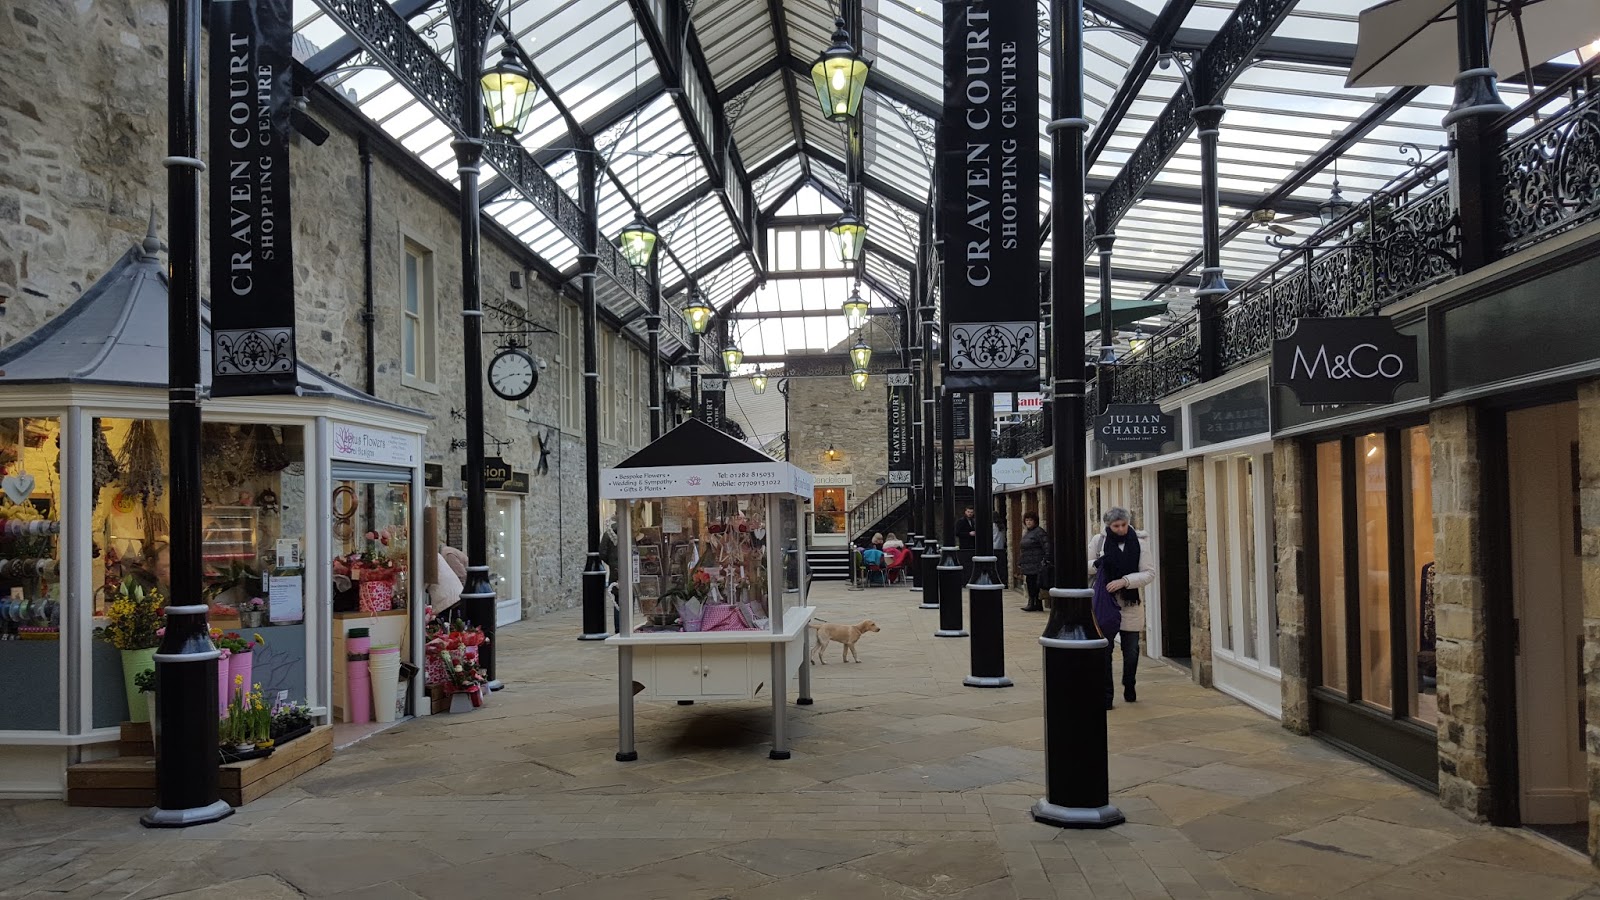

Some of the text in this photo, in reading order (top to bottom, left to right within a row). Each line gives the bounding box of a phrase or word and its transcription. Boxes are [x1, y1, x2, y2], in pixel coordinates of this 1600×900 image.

[229, 32, 252, 296] CRAVEN COURT
[258, 64, 274, 260] SHOPPING CENTRE
[966, 5, 991, 287] CRAVEN COURT
[1001, 41, 1018, 250] SHOPPING CENTRE
[892, 395, 900, 425] COURT
[1290, 343, 1403, 380] M&Co
[1102, 425, 1167, 435] CHARLES
[1108, 415, 1160, 425] JULIAN
